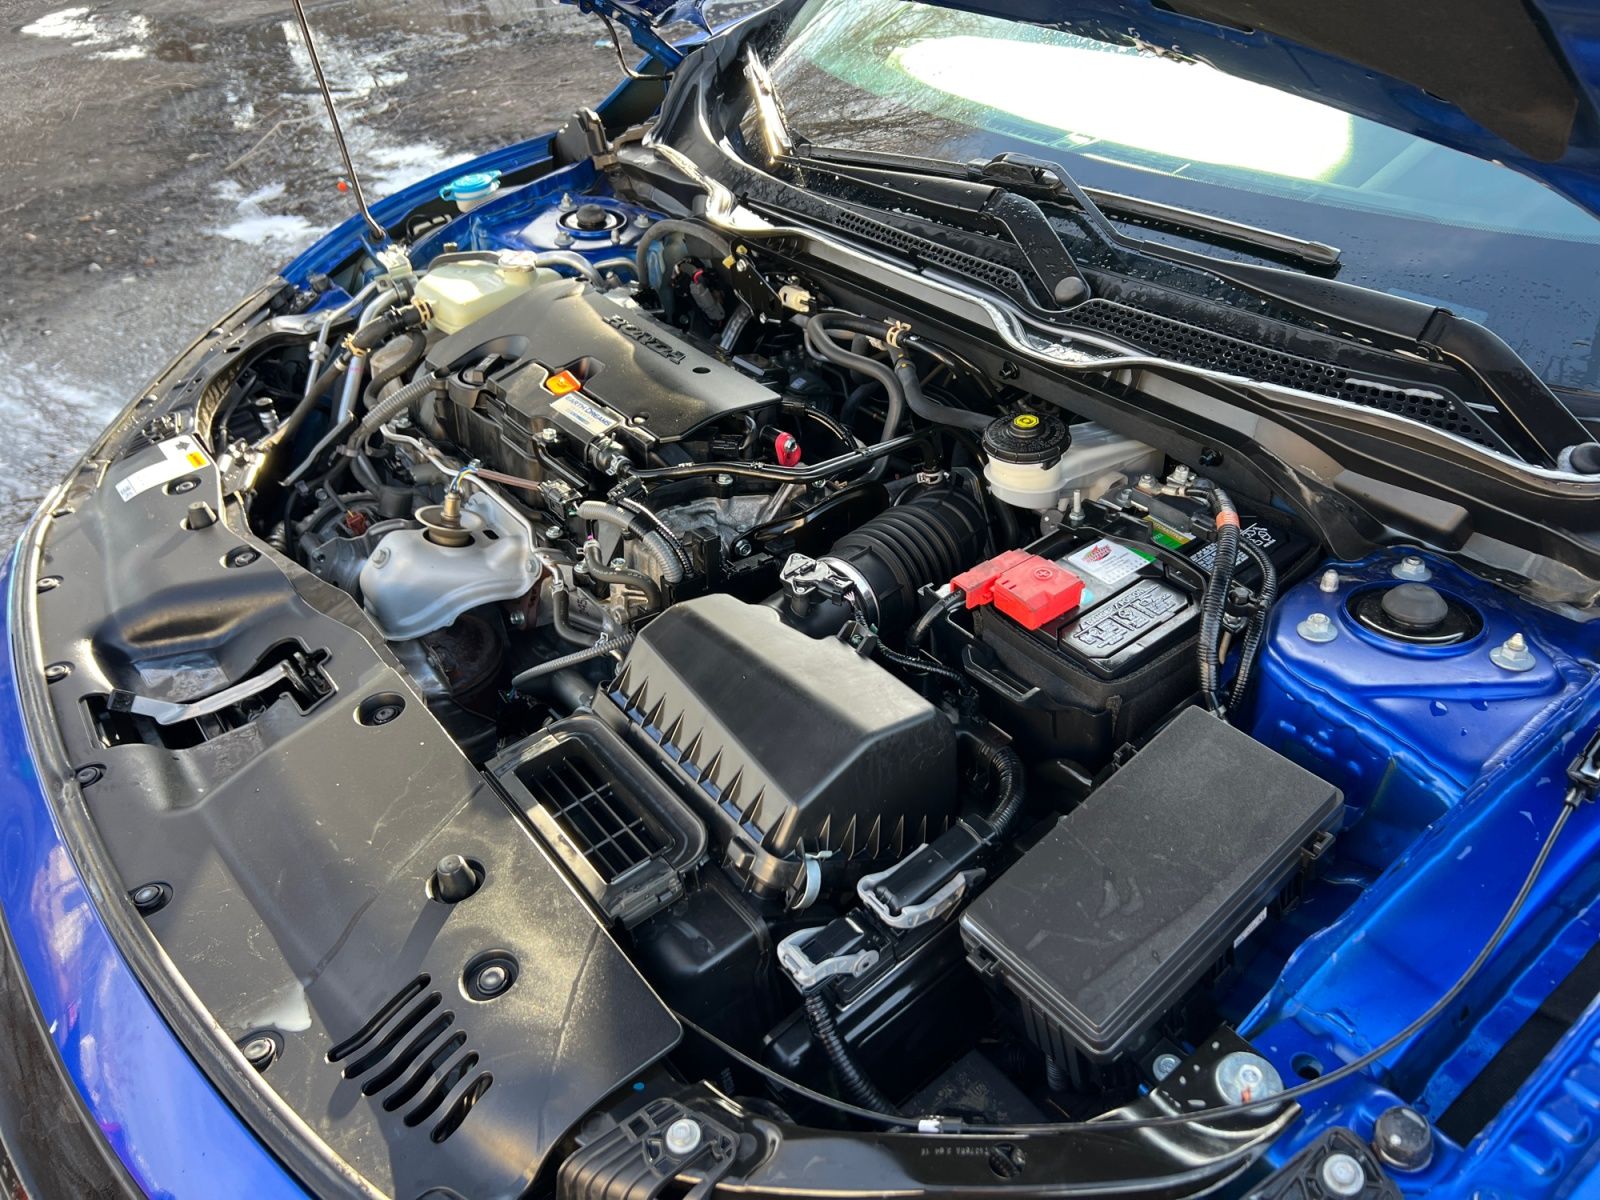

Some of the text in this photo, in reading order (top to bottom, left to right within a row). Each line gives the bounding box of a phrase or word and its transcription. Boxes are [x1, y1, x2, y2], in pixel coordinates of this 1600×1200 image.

[602, 314, 687, 365] HONDA
[565, 395, 587, 410] EARTH
[585, 407, 612, 427] DREAMS
